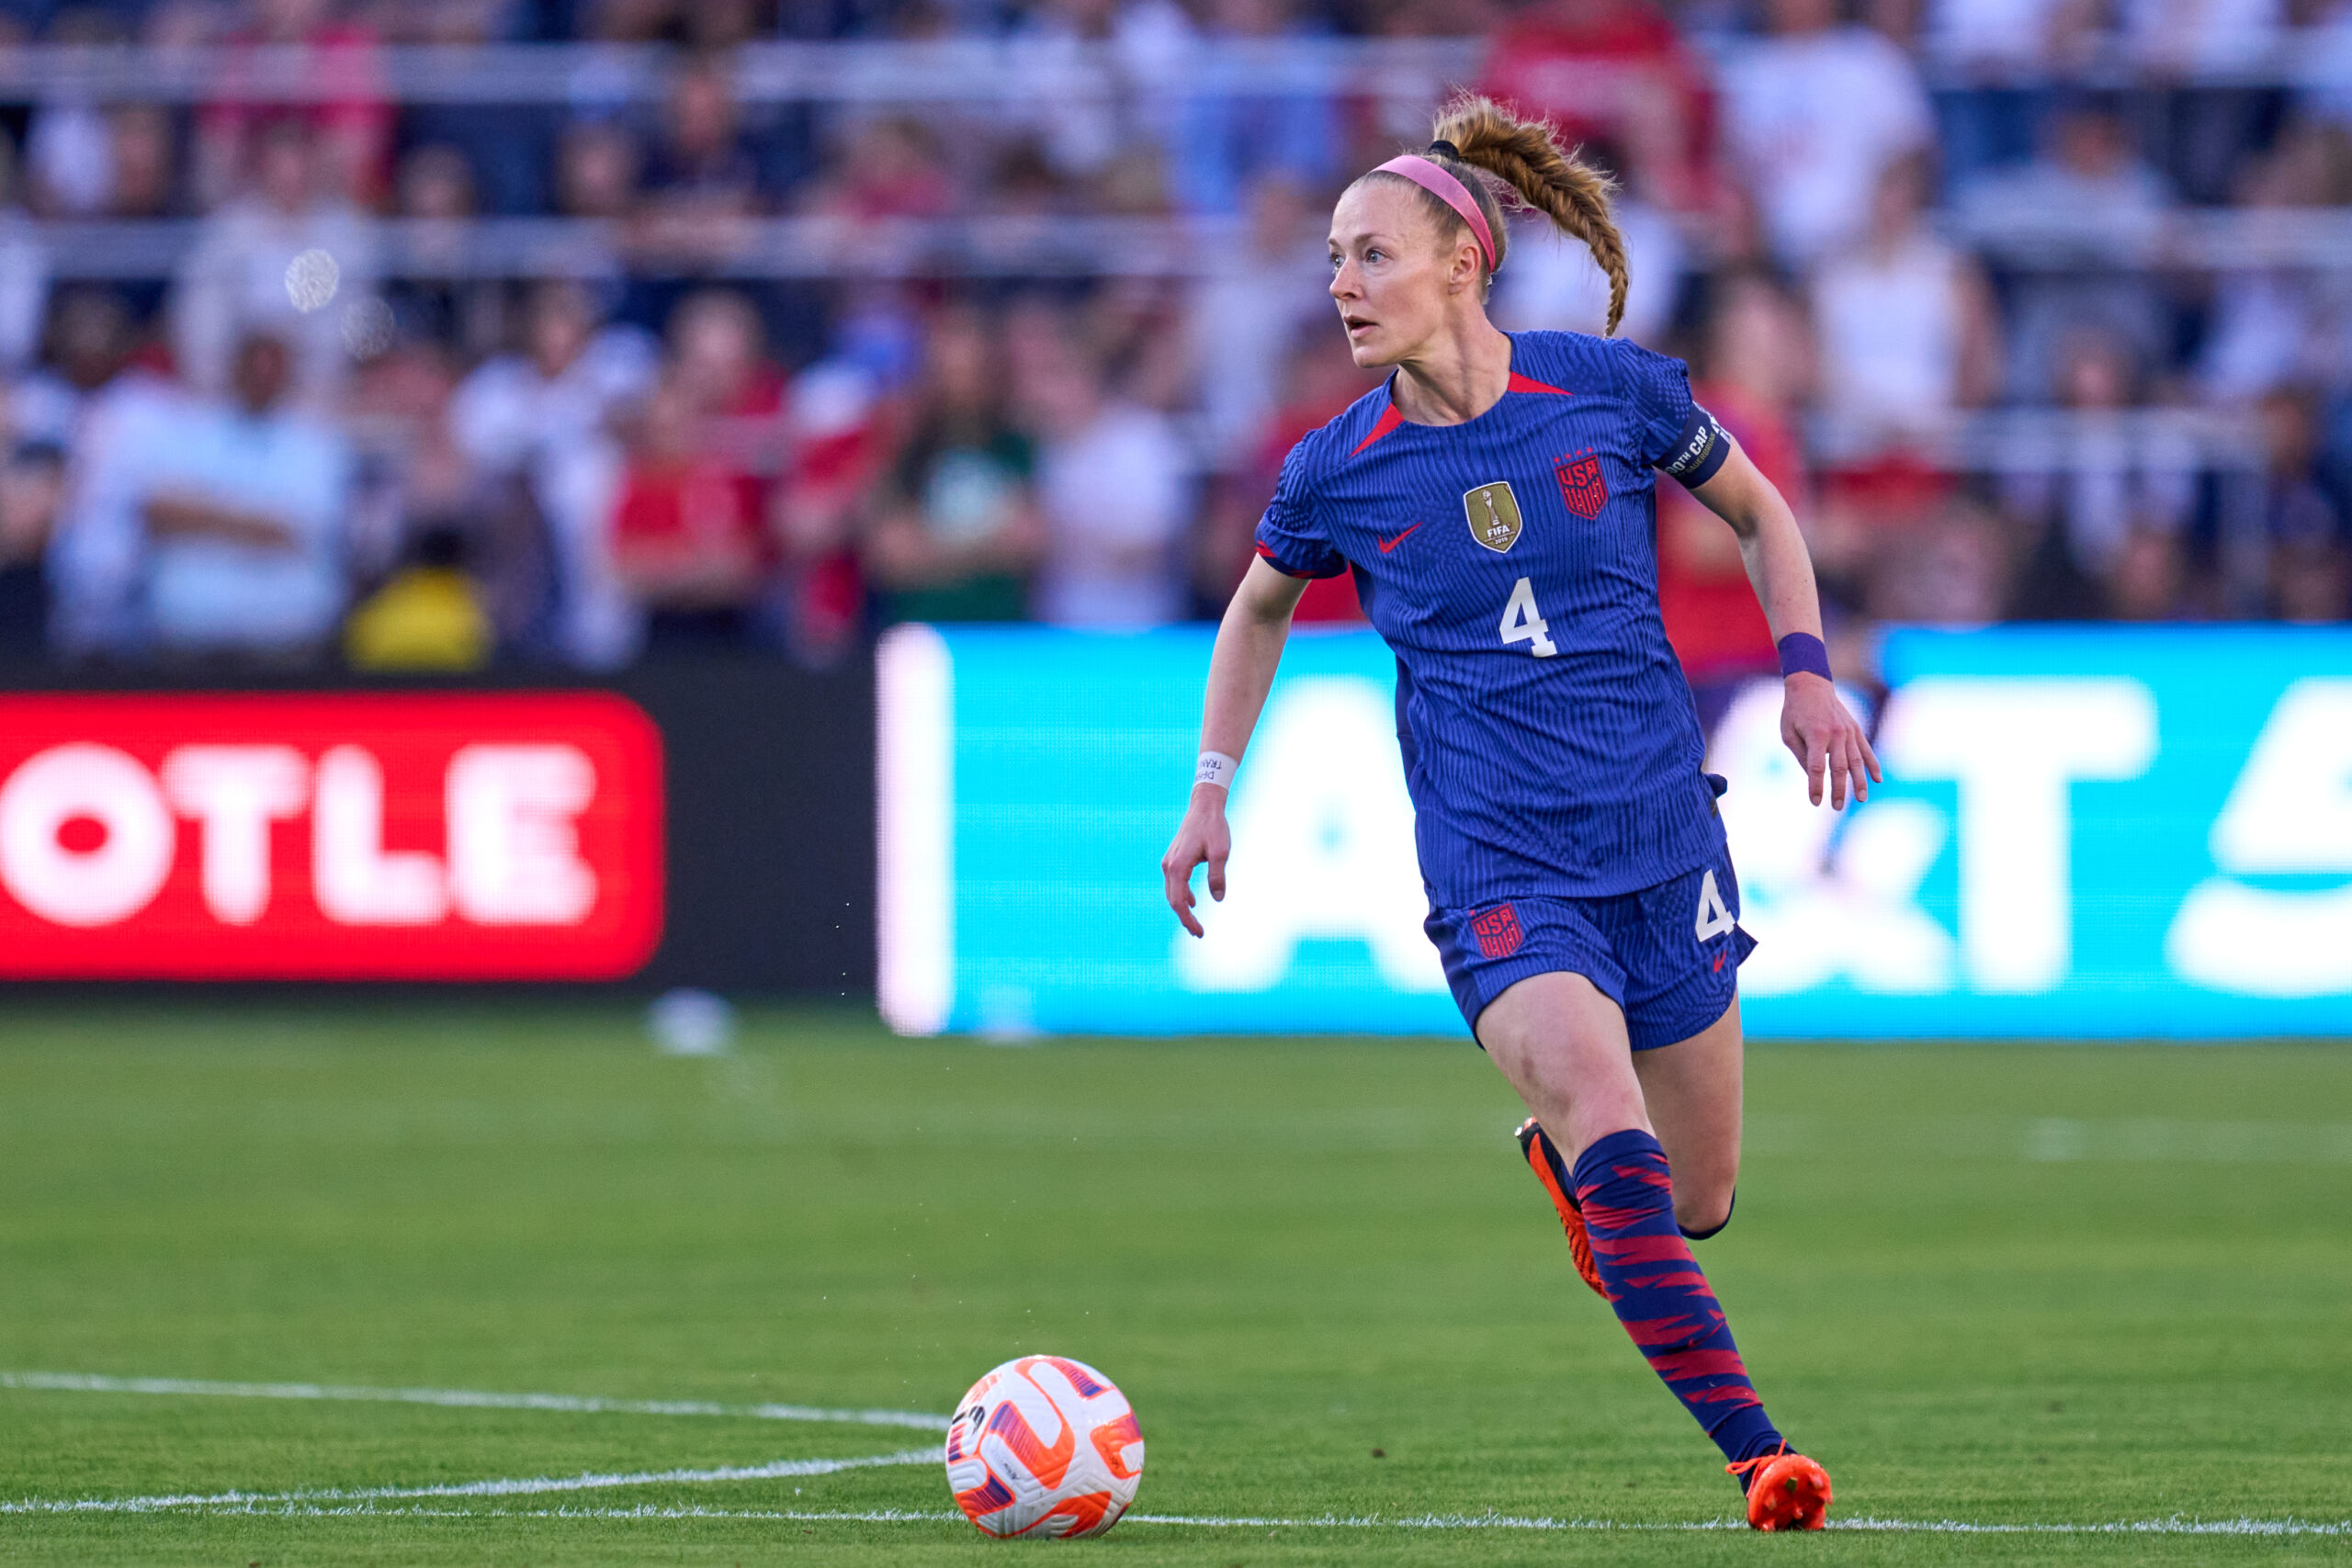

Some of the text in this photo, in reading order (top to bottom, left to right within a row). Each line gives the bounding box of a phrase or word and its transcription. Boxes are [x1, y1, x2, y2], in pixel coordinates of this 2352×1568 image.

[1689, 425, 1709, 456] CAP
[1559, 460, 1599, 487] USA
[1487, 525, 1510, 537] FIFA
[1495, 536, 1510, 545] 2019
[1498, 576, 1558, 658] 4
[0, 740, 599, 927] OTLE
[1695, 869, 1736, 942] 4
[1476, 908, 1513, 935] USA
